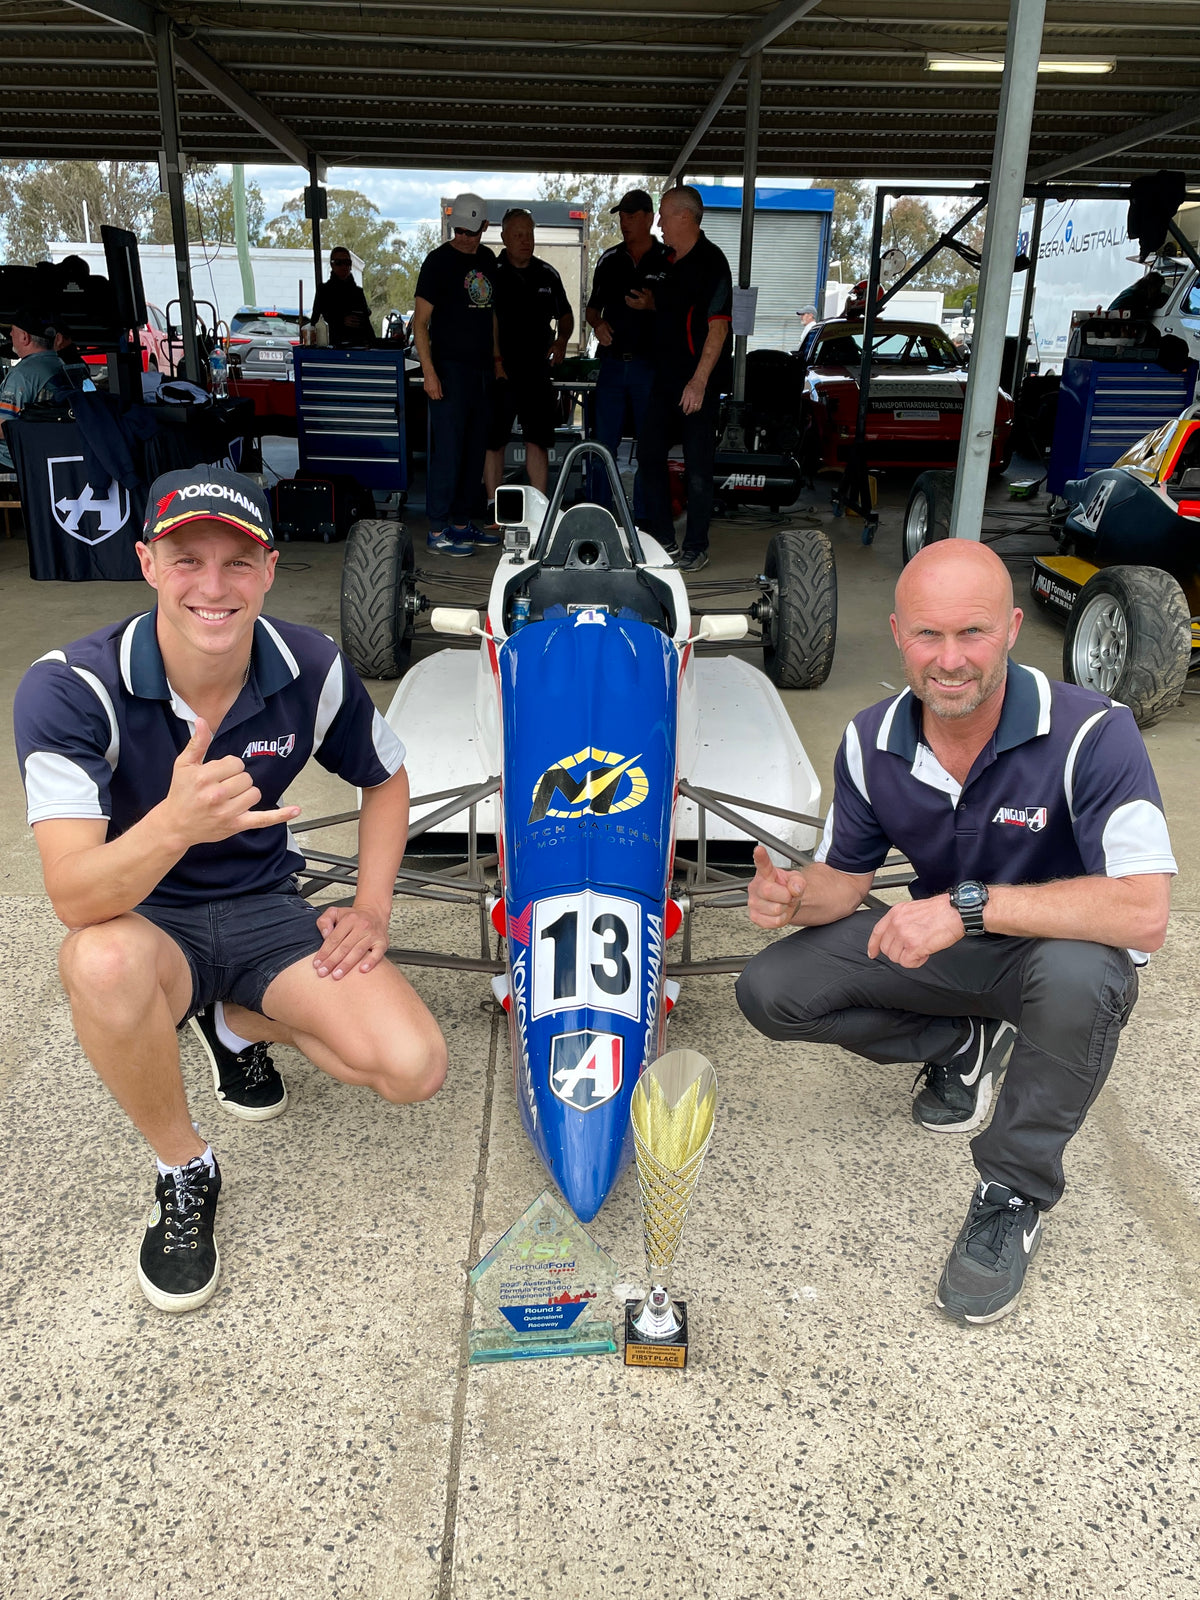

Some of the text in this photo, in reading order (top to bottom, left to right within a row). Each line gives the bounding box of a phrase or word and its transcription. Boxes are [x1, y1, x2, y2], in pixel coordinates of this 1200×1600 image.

[1038, 225, 1131, 260] EGRA AUSTRALIA
[872, 401, 964, 410] TRANSPORTHARDWARE.COM.AU
[720, 473, 766, 490] ANGLO
[178, 483, 263, 522] YOKOHAMA
[1051, 581, 1072, 602] Formula
[241, 740, 277, 759] ANGLO
[991, 807, 1026, 823] ANGLO
[541, 910, 632, 1000] 13
[513, 949, 538, 1131] YOKOHAMA
[517, 1237, 573, 1260] 1st
[523, 1279, 561, 1287] Australian
[500, 1292, 555, 1300] Championship
[523, 1314, 564, 1322] Queensland
[525, 1306, 554, 1314] Round
[528, 1321, 559, 1329] Raceway
